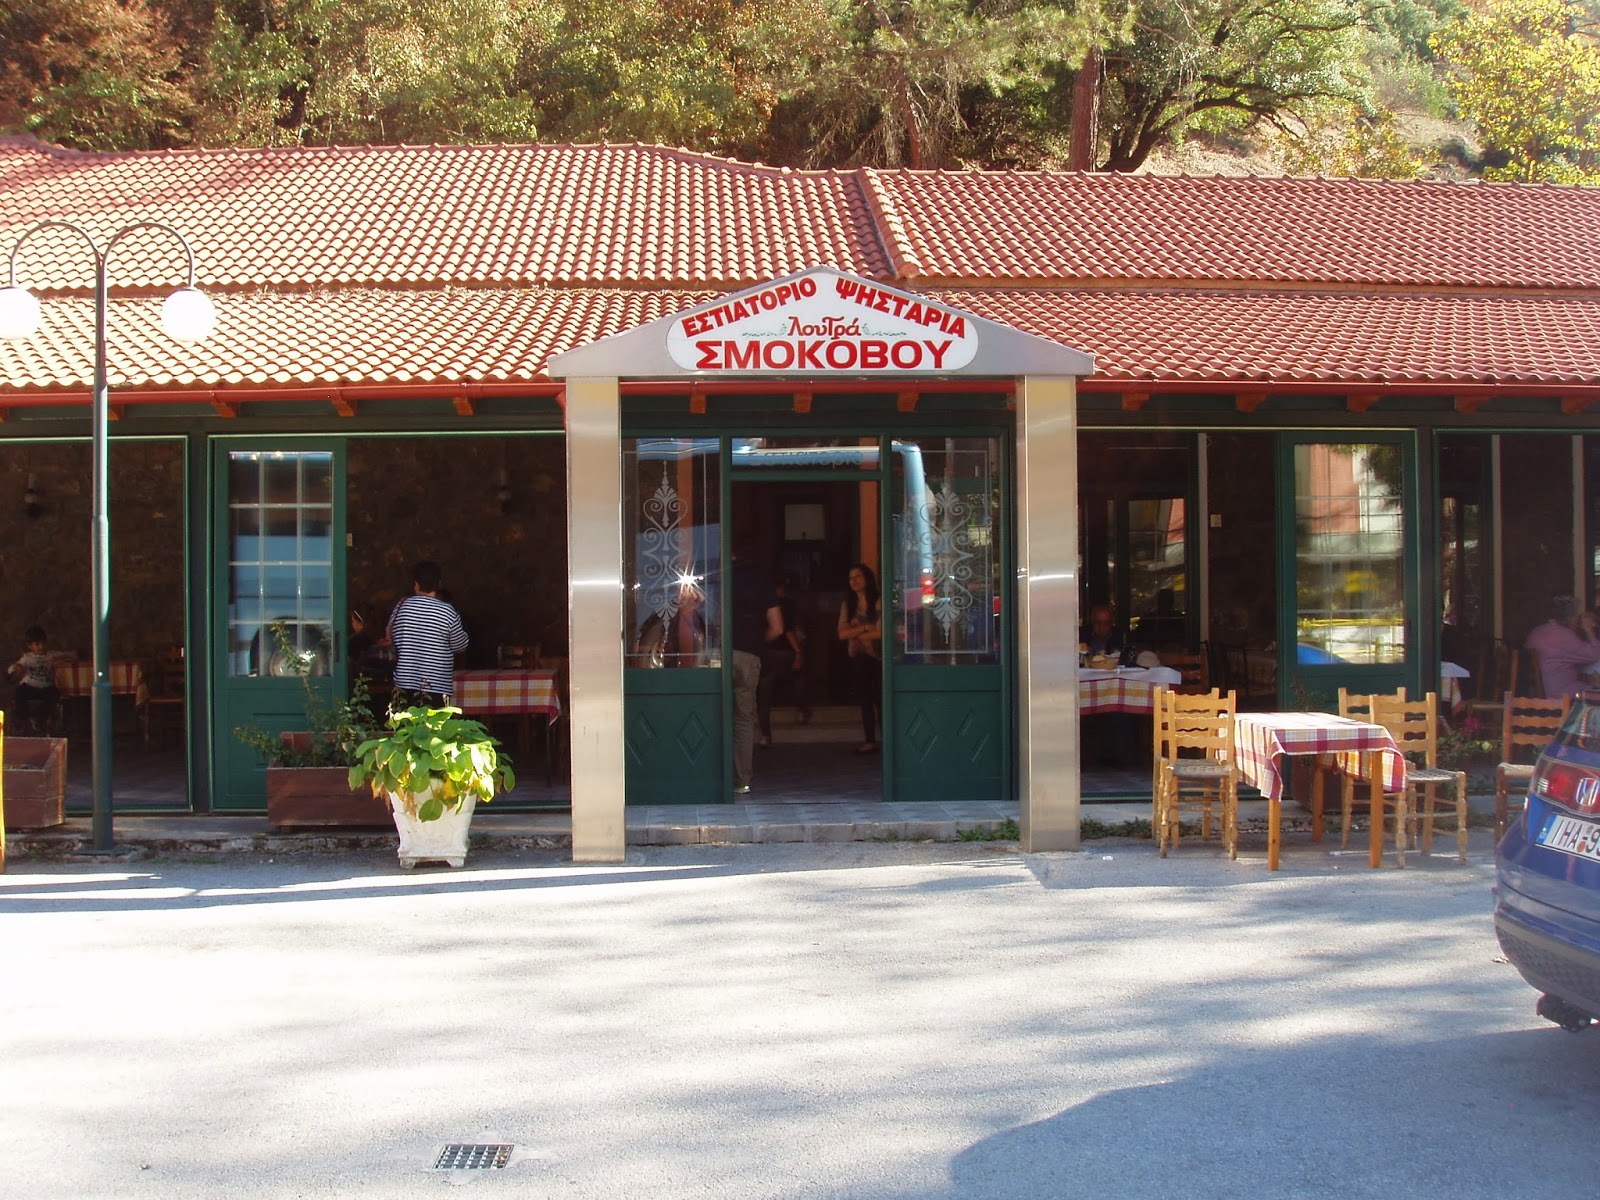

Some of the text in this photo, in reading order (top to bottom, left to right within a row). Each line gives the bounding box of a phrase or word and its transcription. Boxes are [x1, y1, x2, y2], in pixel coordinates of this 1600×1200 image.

[681, 277, 966, 339] ΕΣΤΙΑΤΟΡΙΟ ΨΗΣΤΑΡΙΑ
[695, 340, 954, 369] ΣΜΟΚΟΒΟΥ
